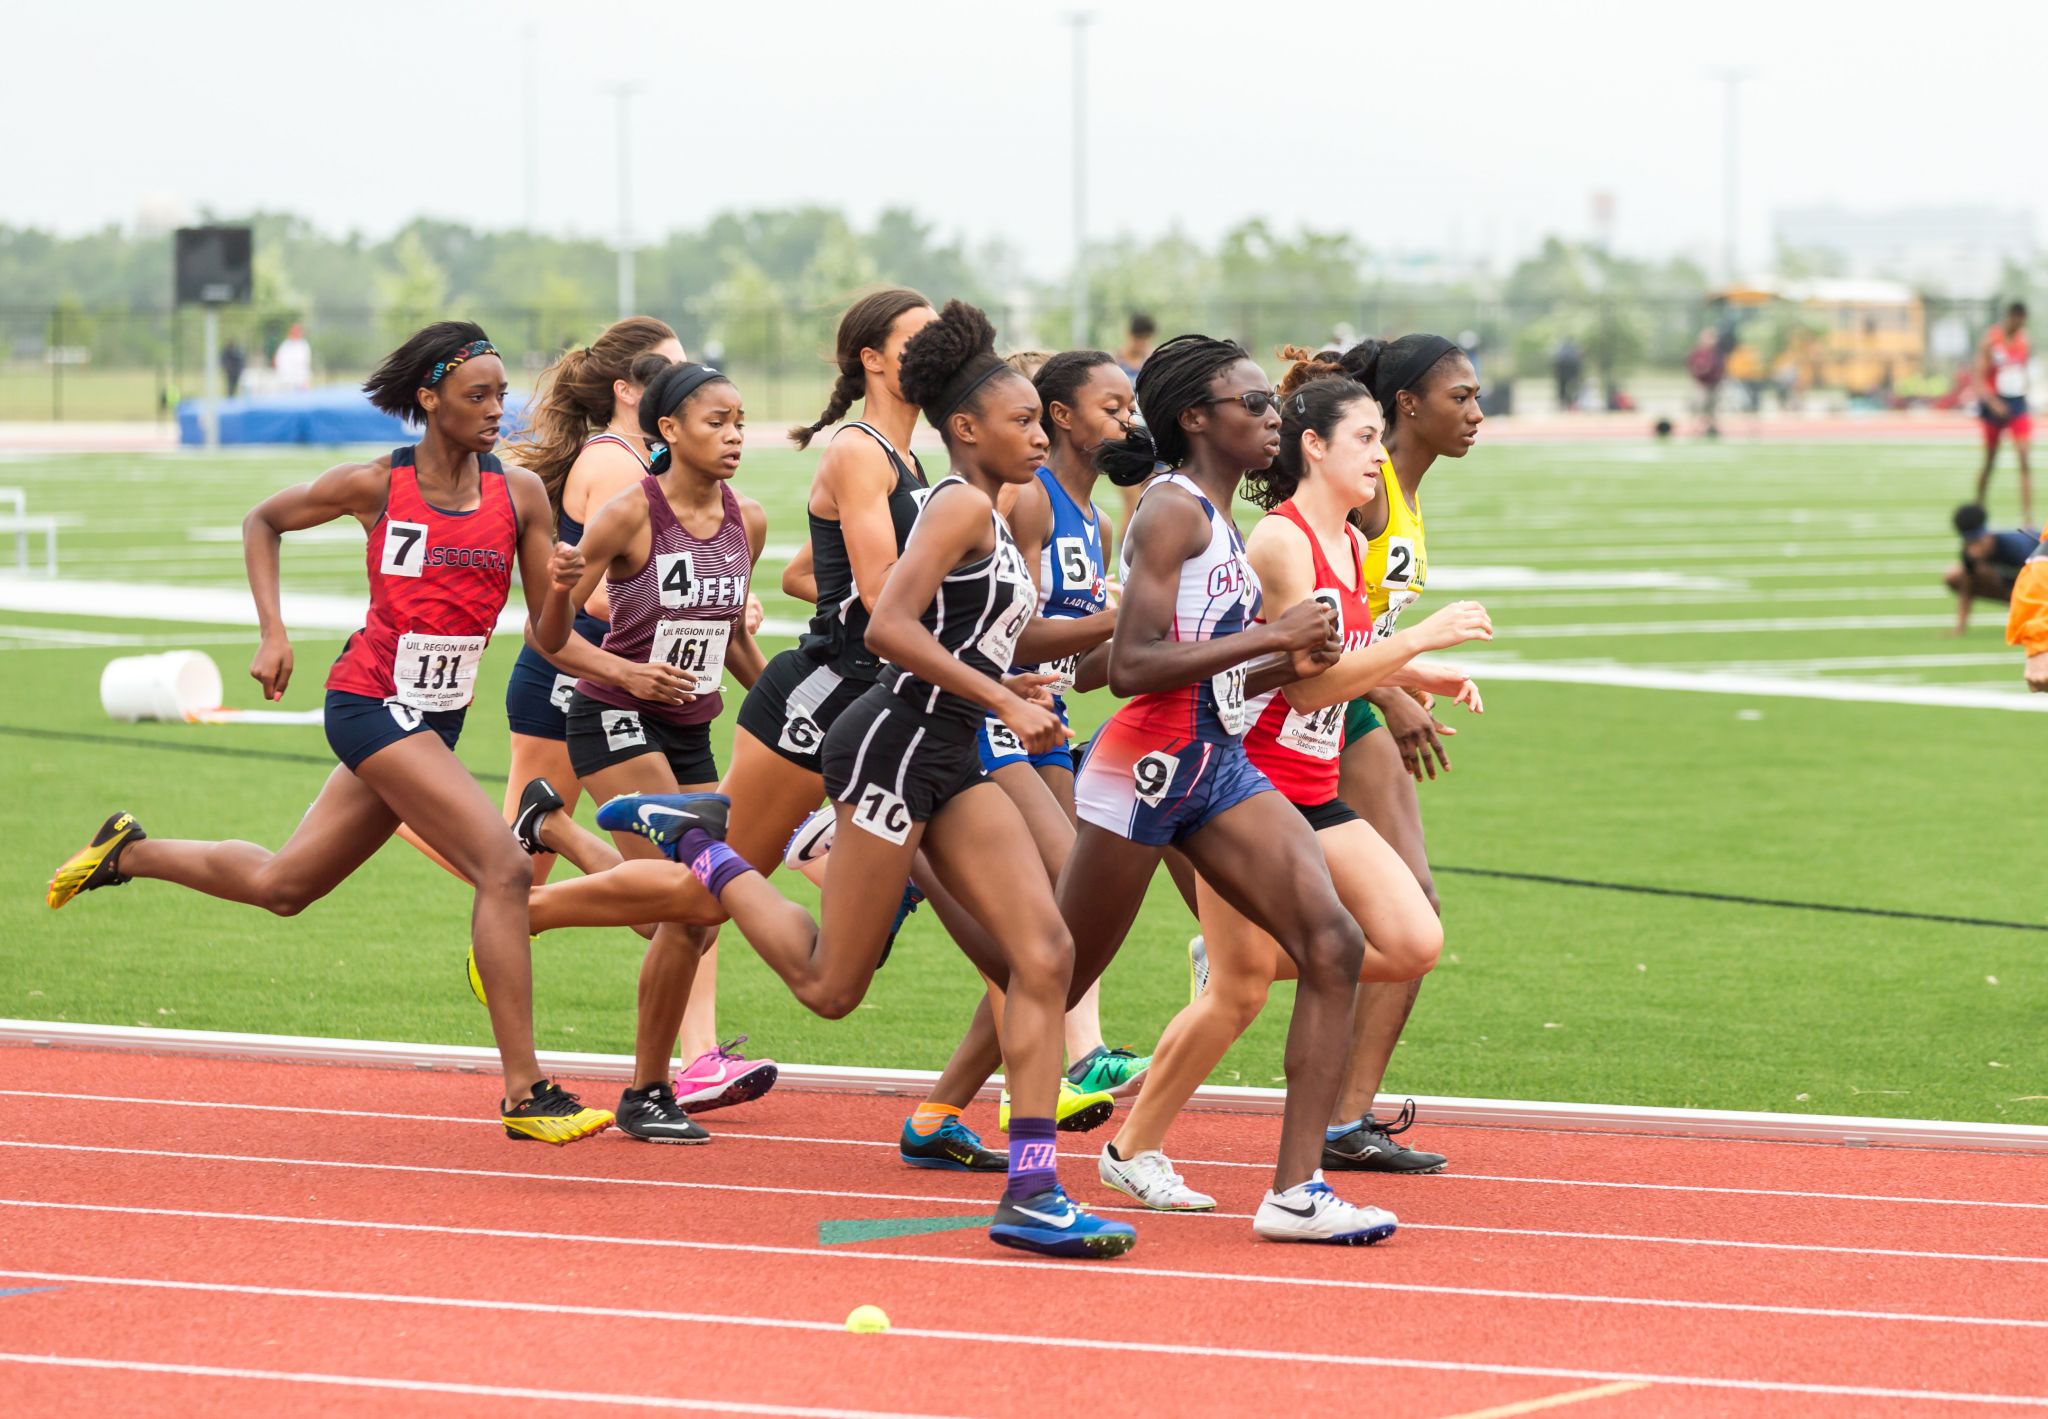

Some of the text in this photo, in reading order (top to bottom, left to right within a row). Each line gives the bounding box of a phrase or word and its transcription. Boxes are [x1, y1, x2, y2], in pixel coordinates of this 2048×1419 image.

[391, 527, 421, 566] 7
[1386, 546, 1410, 582] 2
[662, 559, 691, 596] 4
[1064, 547, 1087, 582] 5
[1063, 596, 1087, 608] LADY
[406, 641, 420, 651] UIL
[422, 642, 458, 652] REGION
[663, 627, 725, 636] UIL REGION III 6A
[413, 654, 462, 690] 131
[666, 637, 710, 672] 461
[609, 717, 640, 738] 4
[788, 717, 819, 748] 6
[1291, 728, 1319, 743] Challenger
[1296, 740, 1317, 751] Stadium
[1136, 757, 1167, 796] 9
[865, 793, 908, 833] 10
